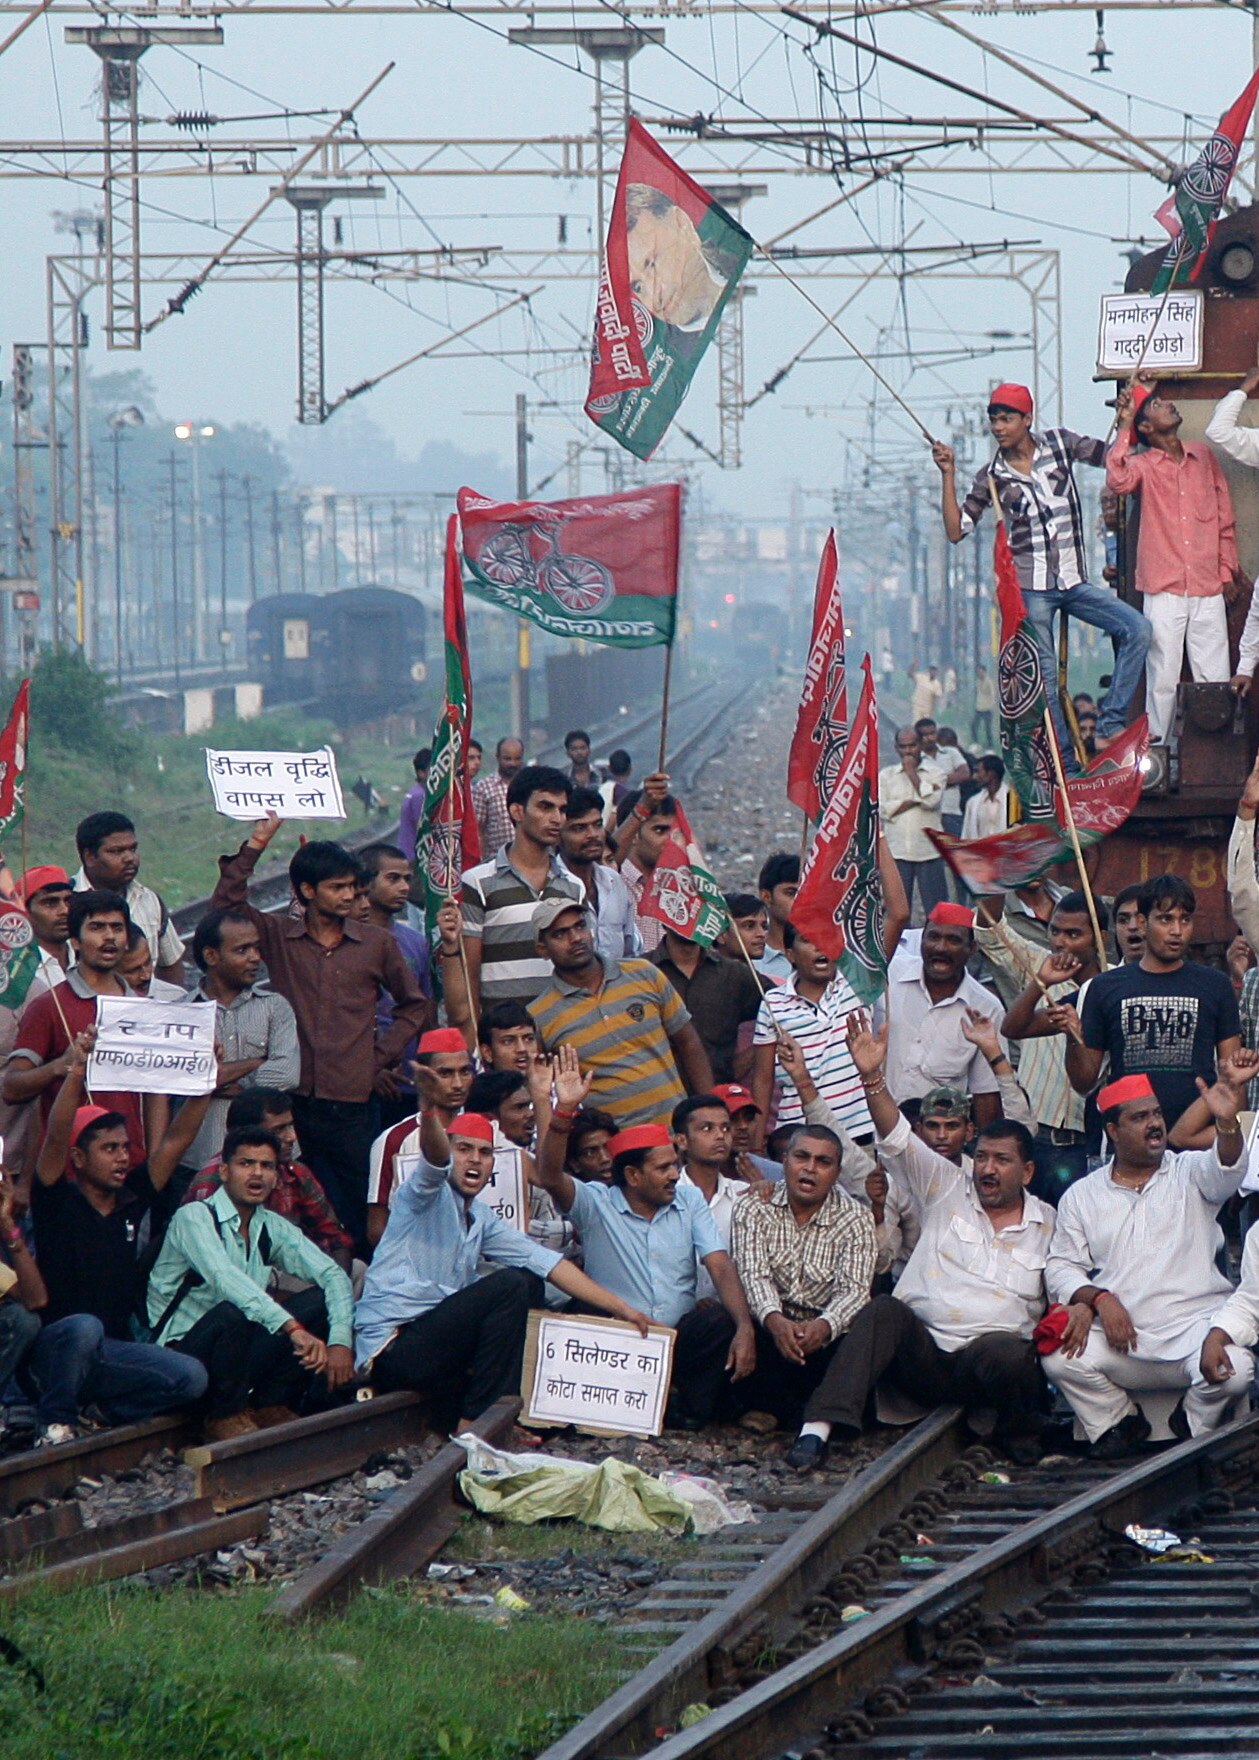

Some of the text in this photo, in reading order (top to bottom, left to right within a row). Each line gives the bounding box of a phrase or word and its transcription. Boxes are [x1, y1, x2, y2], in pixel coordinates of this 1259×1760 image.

[1107, 302, 1195, 324] मनमोहन सिंह
[1114, 333, 1184, 359] गद्दी छोड़ो
[611, 342, 643, 381] पार्टी
[212, 757, 330, 784] डीजल वृद्धि
[224, 788, 326, 808] वापस लो
[546, 1338, 660, 1375] 6 सिलेण्डर का
[546, 1375, 576, 1400] कोटा
[581, 1383, 619, 1406] समाप्त
